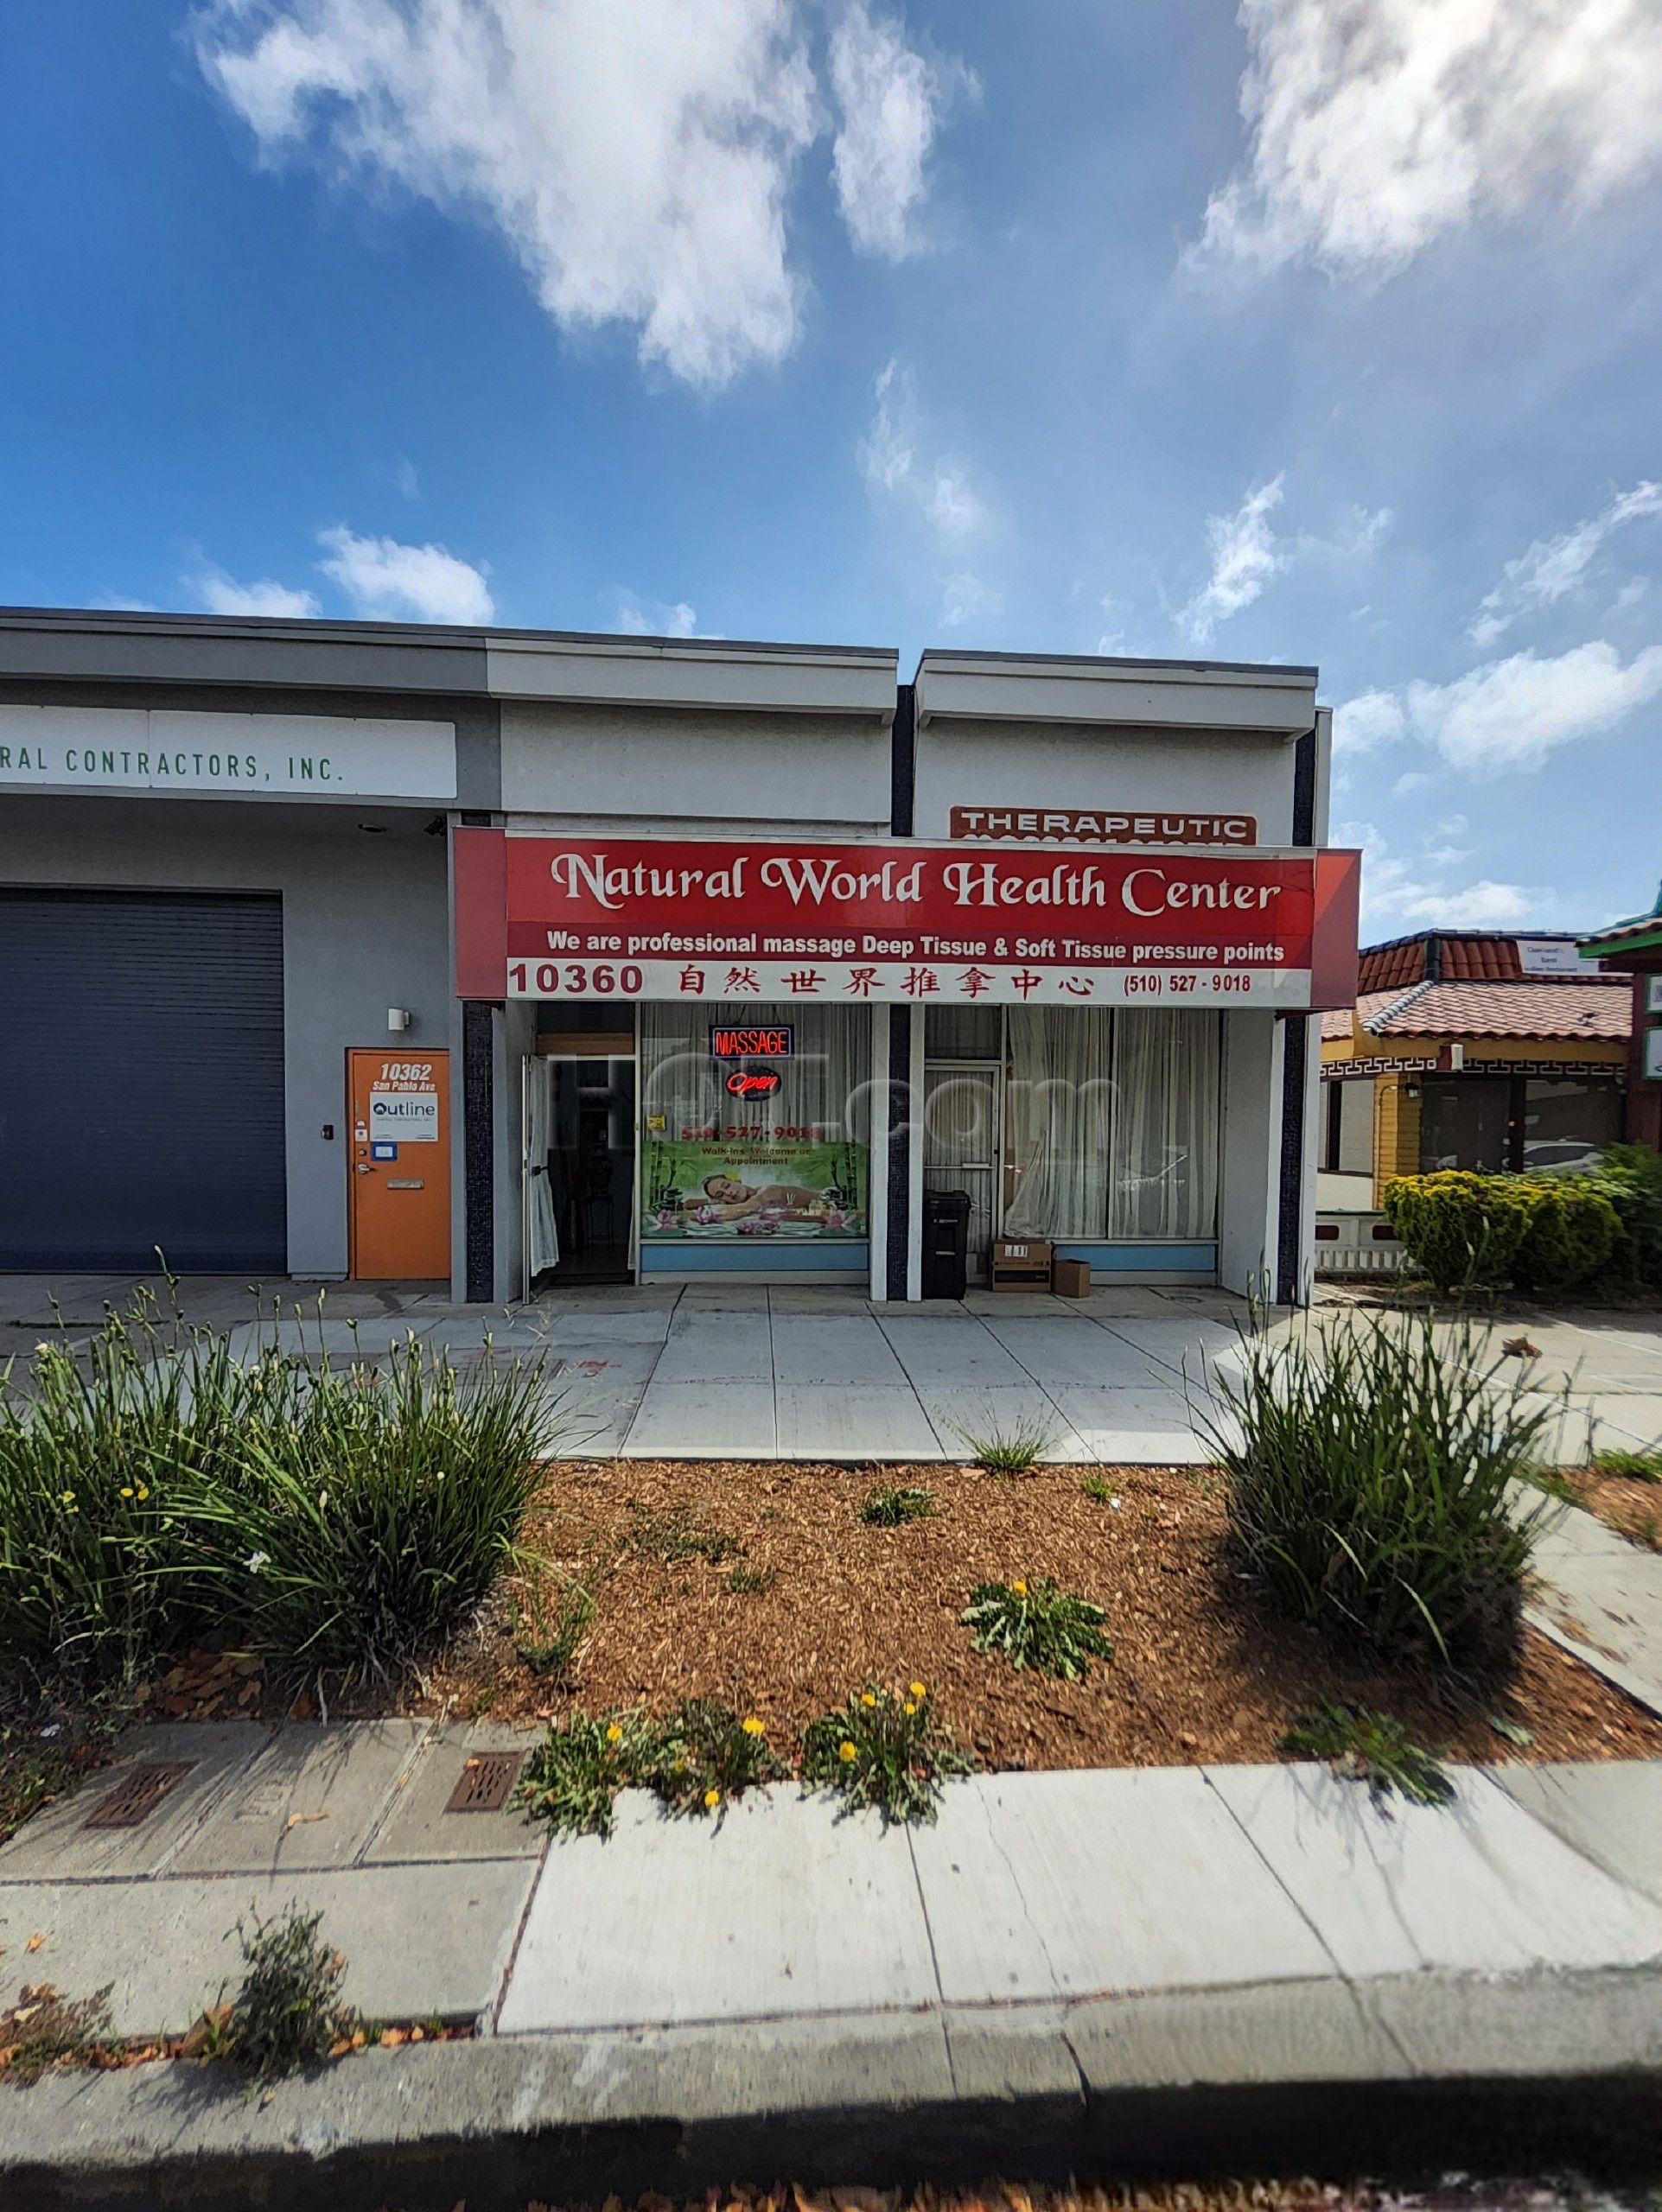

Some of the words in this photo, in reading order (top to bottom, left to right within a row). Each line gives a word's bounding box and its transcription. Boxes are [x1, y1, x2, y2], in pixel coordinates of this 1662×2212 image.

[66, 749, 271, 781] CONTRACTORS,
[288, 757, 343, 781] INC.
[961, 812, 1248, 838] THERAPEUTIC
[551, 853, 750, 910] Natural
[761, 857, 927, 906] World
[943, 861, 1107, 908] Health
[1122, 868, 1281, 918] Center
[547, 931, 579, 950] We
[587, 936, 621, 950] are
[627, 932, 757, 957] professional
[762, 938, 856, 958] massage
[863, 936, 914, 959] Deep
[920, 936, 987, 957] Tissue
[994, 938, 1009, 957] &
[1016, 938, 1056, 959] Soft
[1062, 940, 1127, 961] Tissue
[1132, 944, 1219, 964] pressure
[1224, 942, 1284, 963] points
[509, 964, 643, 994] 10360
[678, 964, 1094, 1001] 自然世界推拿中心
[1124, 975, 1162, 996] (510)
[716, 1031, 787, 1055] MASSAGE
[380, 1064, 431, 1081] 10362
[727, 1072, 778, 1096] Open
[373, 1081, 390, 1090] San
[392, 1081, 417, 1090] Pablo
[419, 1082, 436, 1091] Ave
[373, 1102, 435, 1116] Outline
[723, 1157, 788, 1166] Appointment
[750, 1147, 795, 1156] Welcome
